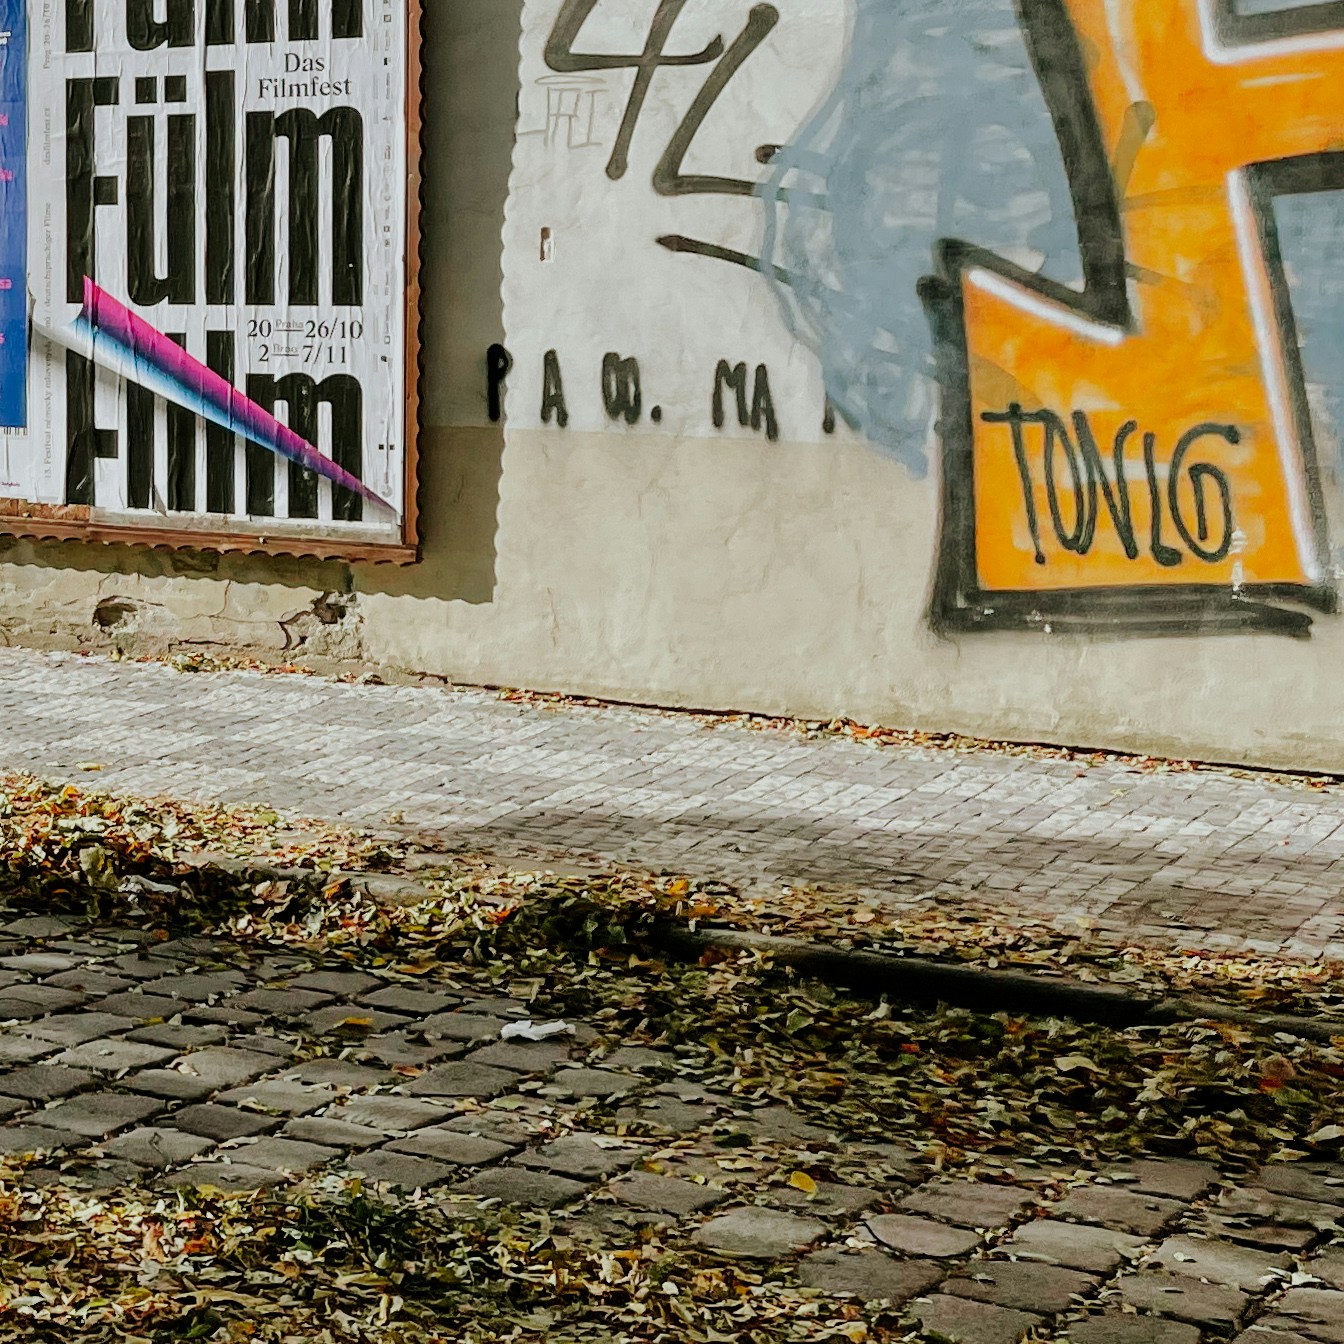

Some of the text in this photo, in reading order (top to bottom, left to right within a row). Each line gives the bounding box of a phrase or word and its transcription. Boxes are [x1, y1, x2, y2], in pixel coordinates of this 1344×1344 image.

[284, 52, 325, 73] Das
[258, 76, 352, 99] Filmfest
[65, 69, 363, 306] Fülm
[247, 319, 272, 338] 20
[305, 317, 363, 340] 26/10
[258, 344, 269, 362] 2
[302, 341, 346, 365] 7/11
